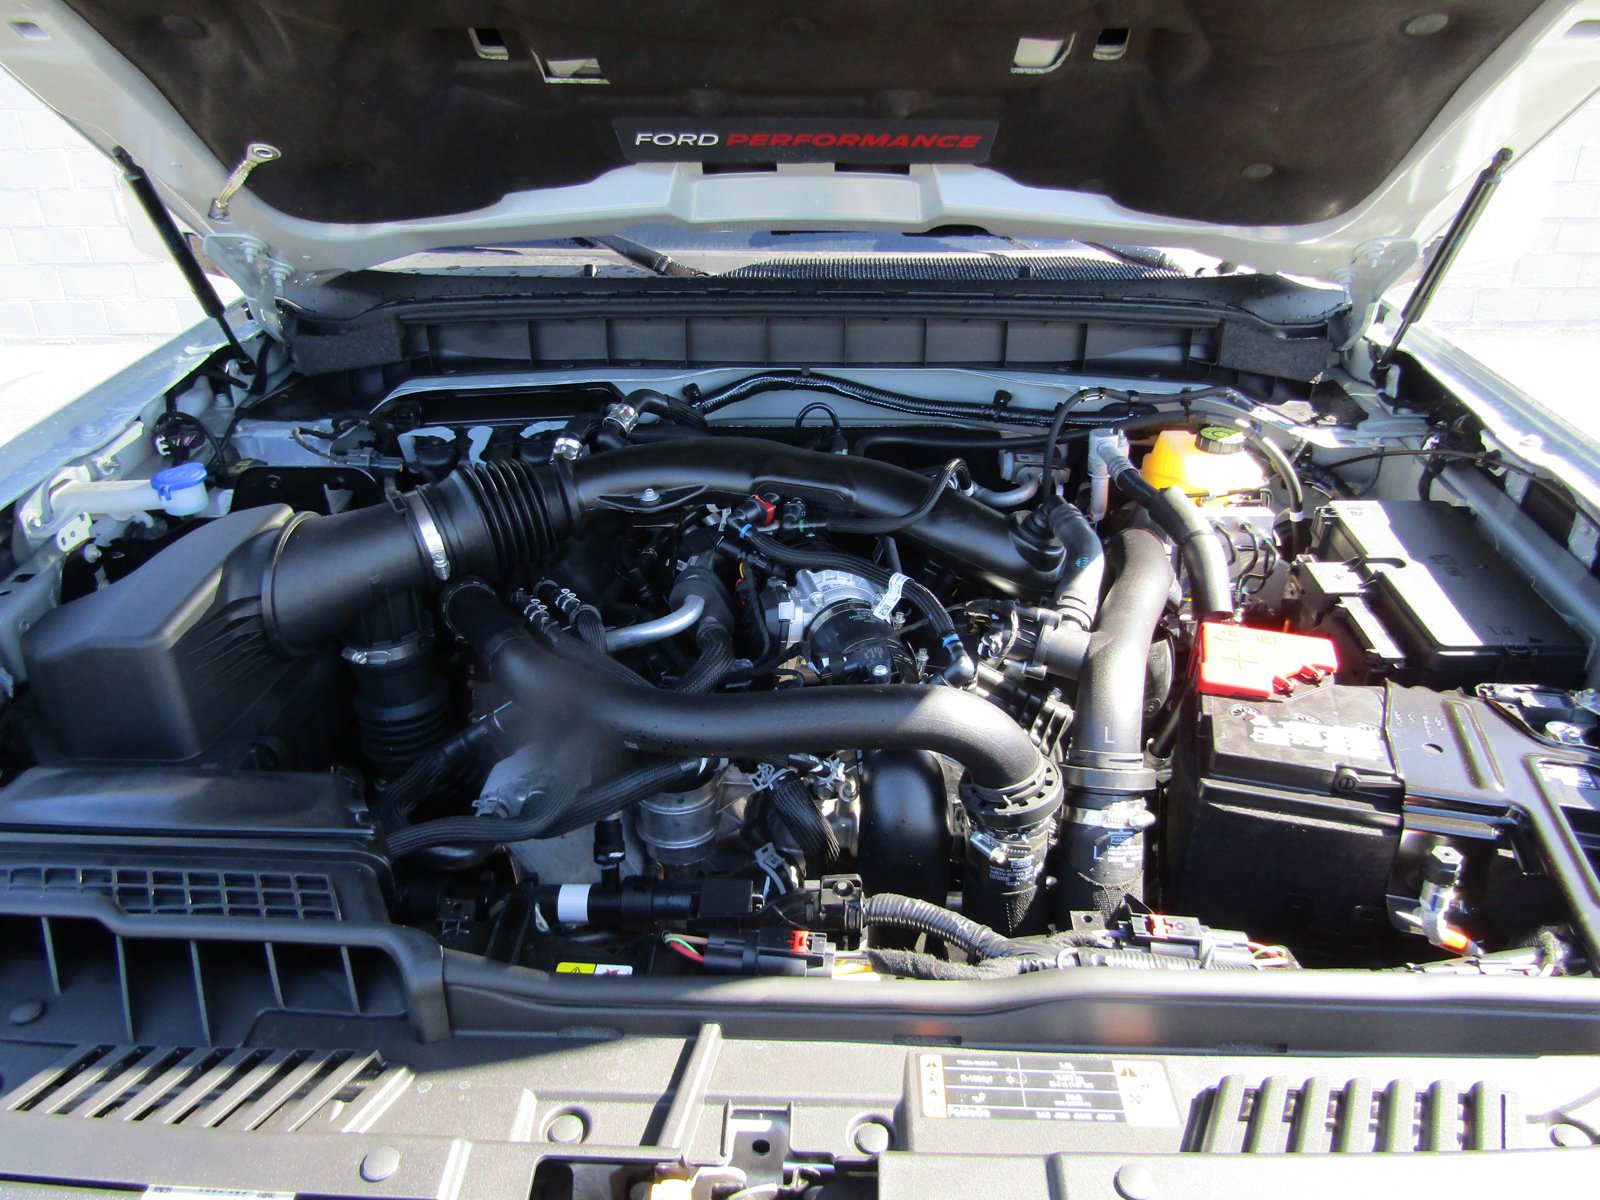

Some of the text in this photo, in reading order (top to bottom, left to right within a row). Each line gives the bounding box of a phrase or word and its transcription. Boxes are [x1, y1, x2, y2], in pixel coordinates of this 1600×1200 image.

[635, 133, 982, 148] FORD PERFORMANCE
[1094, 845, 1104, 860] L
